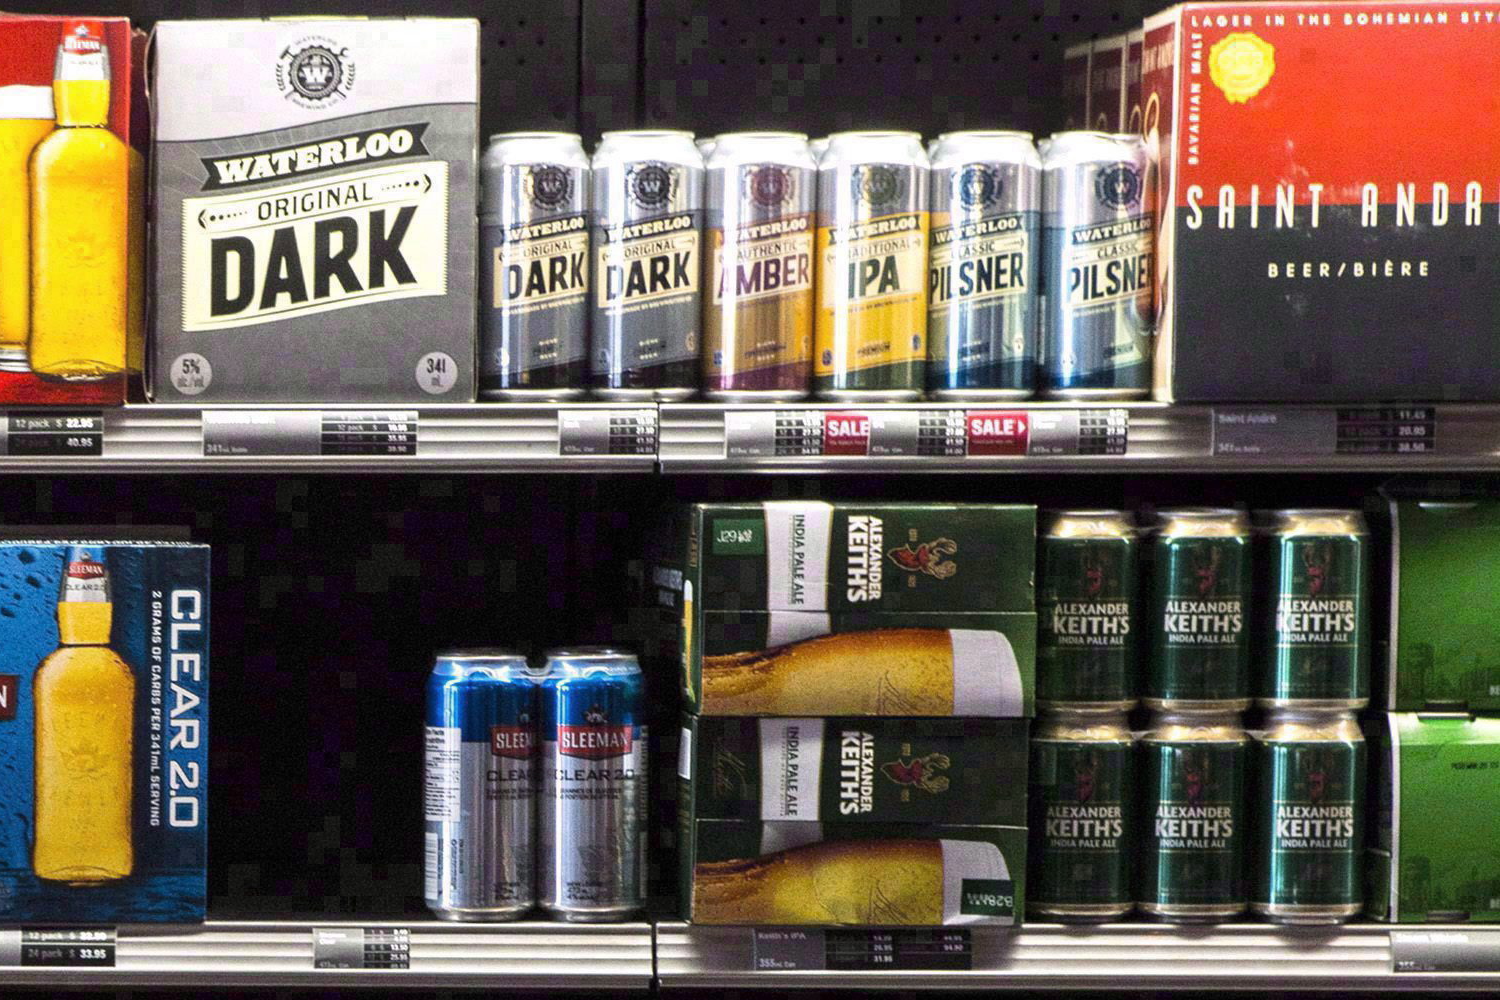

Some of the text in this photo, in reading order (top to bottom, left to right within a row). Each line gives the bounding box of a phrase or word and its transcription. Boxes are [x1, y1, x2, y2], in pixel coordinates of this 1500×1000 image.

[1191, 12, 1500, 27] LAGER IN THE BOHEMIAN STY
[213, 128, 413, 185] WATERLOO
[257, 184, 372, 221] ORIGINAL
[1187, 182, 1500, 228] SAINT ANDR
[209, 205, 418, 317] DARK
[607, 252, 690, 299] DARK
[718, 254, 808, 298] AMBER
[849, 254, 899, 298] IPA
[930, 252, 1024, 304] PILSNER
[828, 421, 869, 436] SALE
[795, 514, 805, 605] INDIA PALE ALE
[847, 515, 869, 603] KEITH'S
[868, 515, 883, 600] ALEXANDER
[152, 601, 162, 645] GRAMS
[1164, 614, 1242, 633] KEITH'S
[1165, 601, 1241, 614] ALEXANDER
[152, 647, 161, 661] OF
[151, 665, 161, 705] CARBS
[151, 709, 160, 729] PER
[170, 589, 201, 827] CLEAR 2.0
[151, 734, 160, 772] 341mL
[563, 732, 628, 749] SLEEMAN
[840, 730, 861, 815] KEITH'S
[860, 732, 874, 813] ALEXANDER
[150, 776, 160, 826] SERVING
[1278, 806, 1352, 820] ALEXANDER
[1277, 820, 1353, 838] KEITH'S
[80, 949, 106, 959] 33.95
